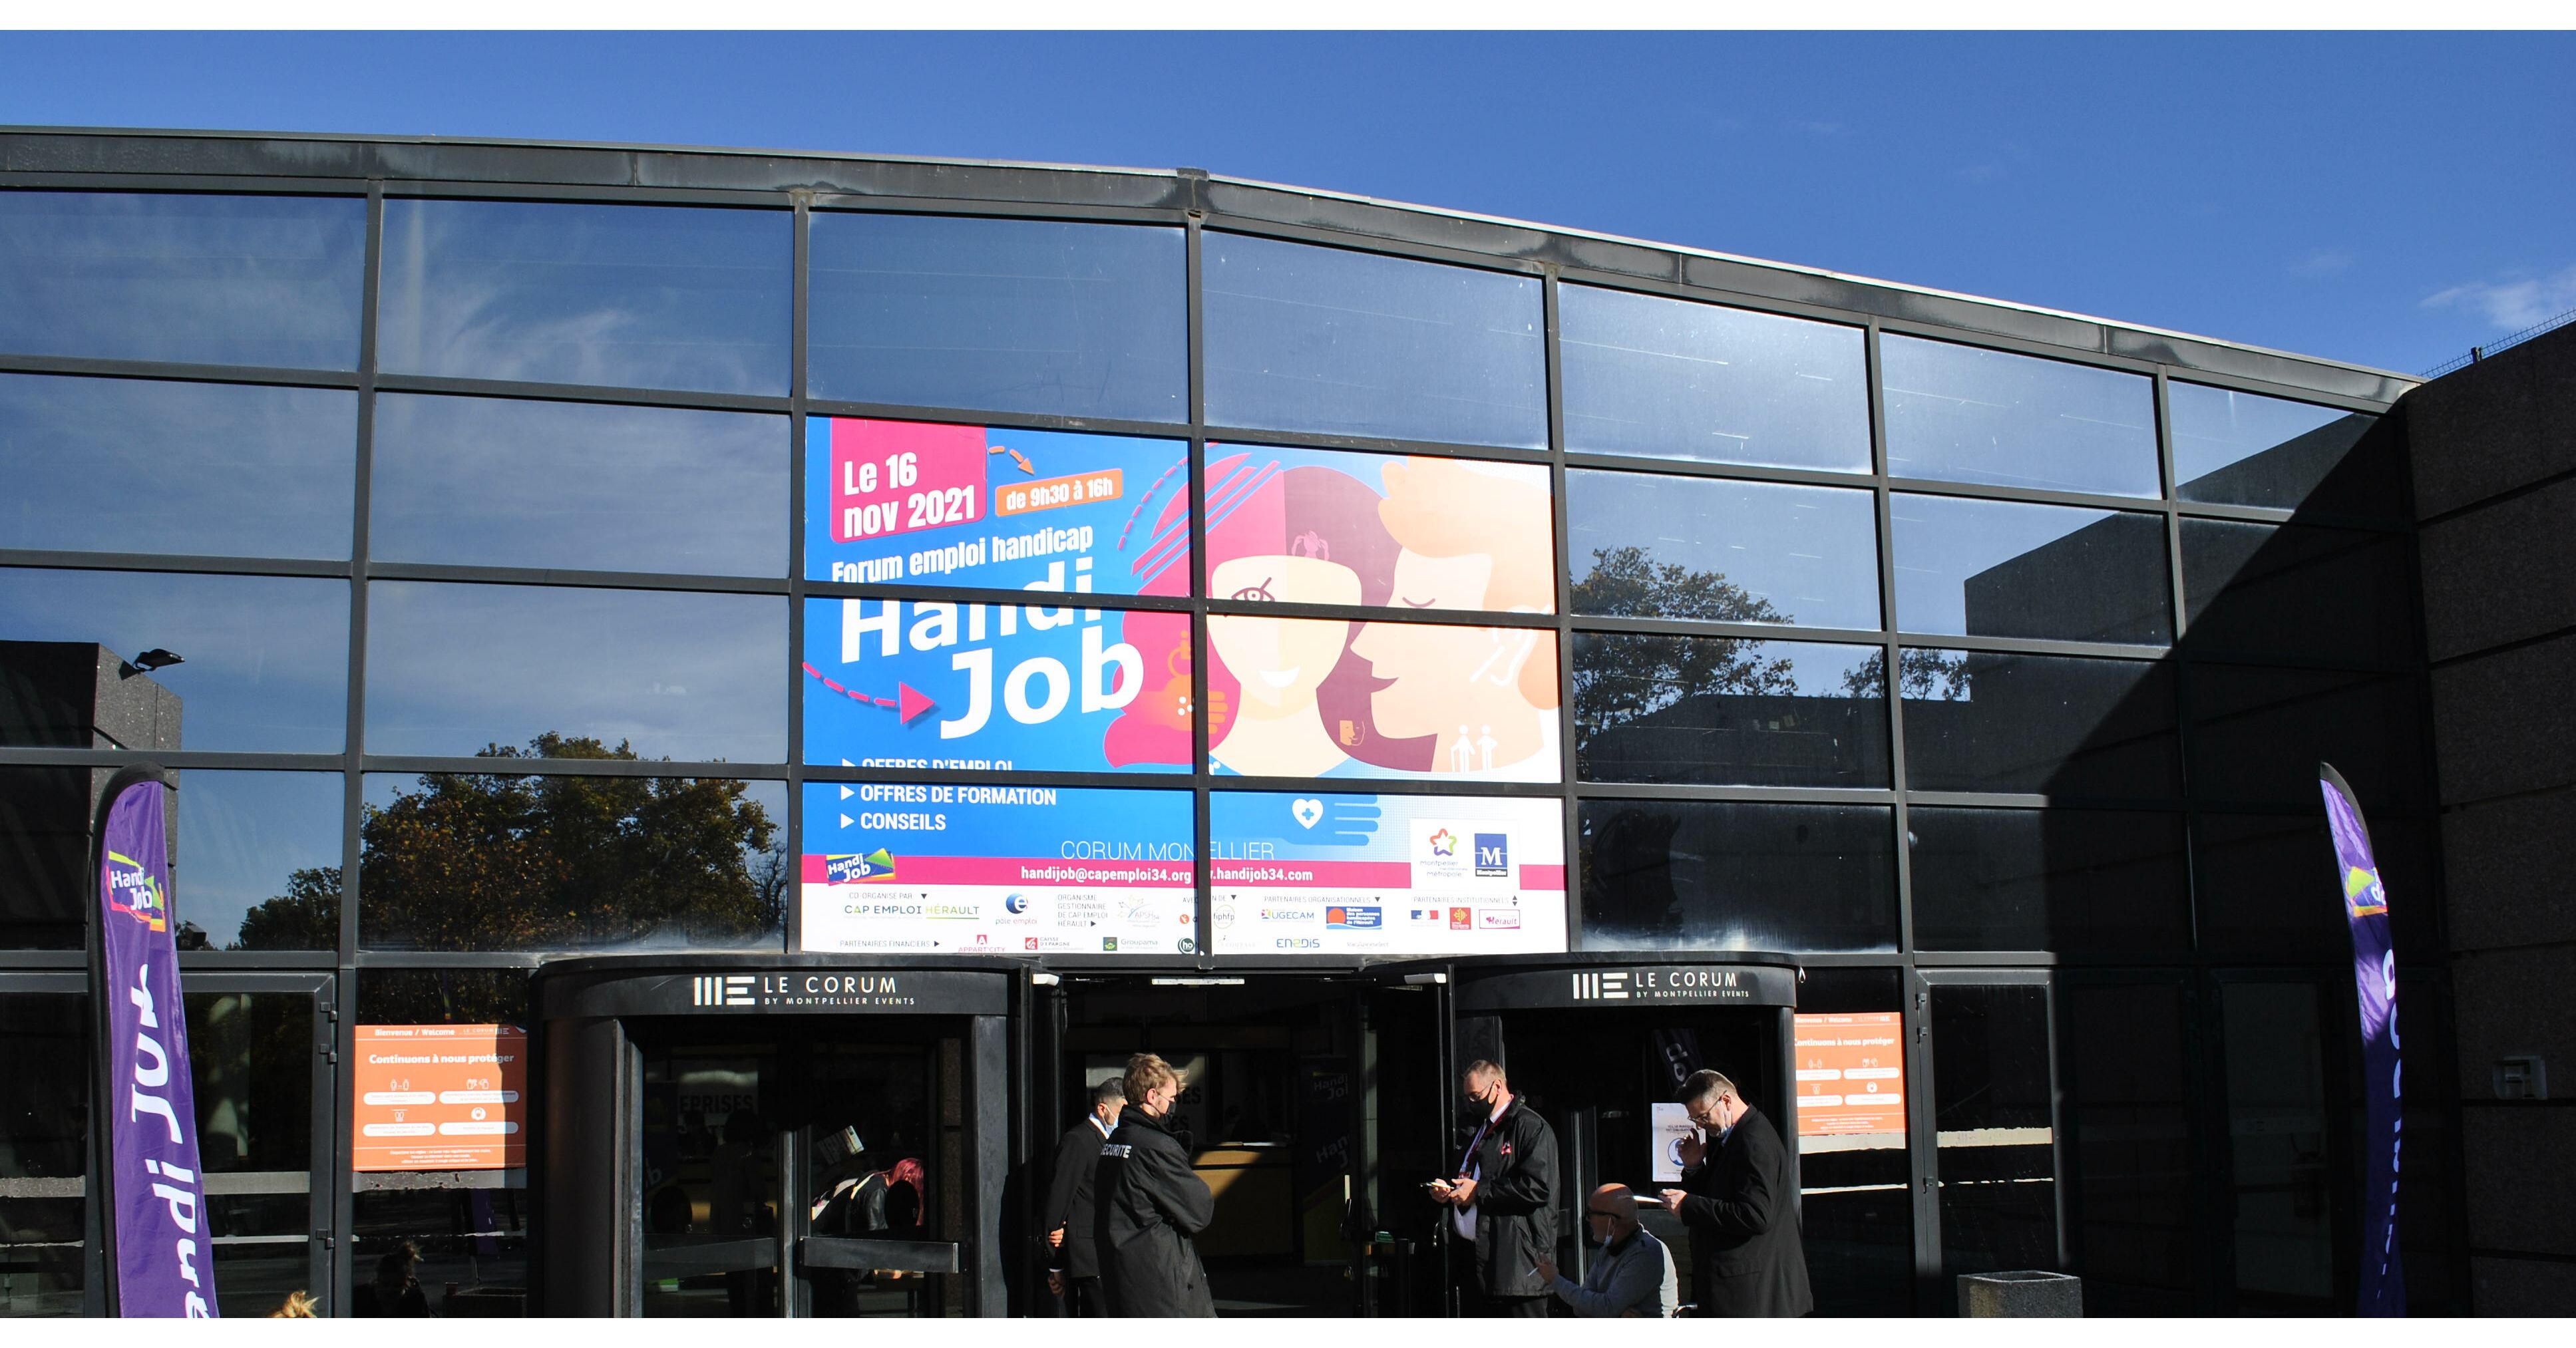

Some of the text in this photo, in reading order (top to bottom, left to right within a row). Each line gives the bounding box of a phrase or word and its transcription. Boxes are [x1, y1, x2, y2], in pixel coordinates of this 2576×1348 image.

[844, 452, 917, 496] Le 16
[1006, 477, 1113, 511] de 9h30 à 16h
[844, 485, 975, 538] nov 2021
[832, 526, 1093, 583] Forum emploi handicap
[842, 557, 1101, 663] Handi
[940, 625, 1144, 739] Job
[860, 785, 1057, 806] OFFRES DE FORMATION
[860, 812, 946, 831] CONSEILS
[1061, 840, 1141, 861] CORUM
[1481, 847, 1503, 866] M
[828, 853, 864, 875] Handi
[843, 864, 871, 882] Job
[1210, 865, 1313, 882] .handijob34.com
[110, 867, 144, 889] Handi
[1021, 866, 1191, 885] handijob@capemploi34.org
[130, 886, 153, 911] Job
[844, 904, 980, 915] CAP EMPLOI HÉRAULT
[1121, 939, 1158, 947] Groupama
[765, 977, 897, 993] LE CORUM
[1636, 971, 1737, 987] LE CORUM
[1863, 1037, 1895, 1047] protéger
[369, 1054, 431, 1064] Continuons
[433, 1054, 439, 1063] à
[468, 1053, 514, 1065] protéger
